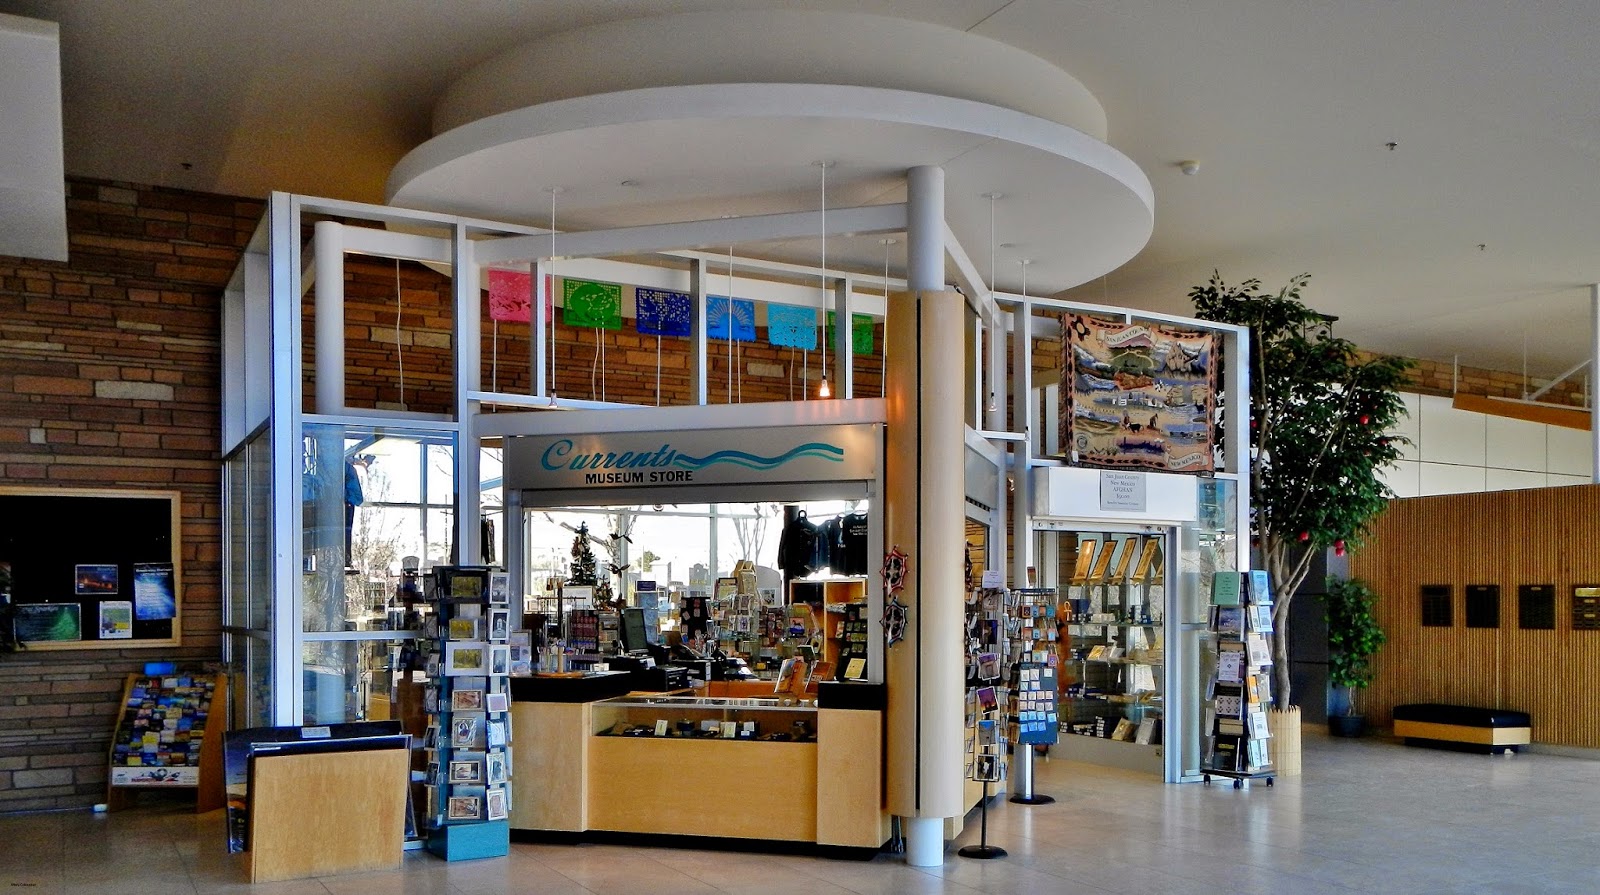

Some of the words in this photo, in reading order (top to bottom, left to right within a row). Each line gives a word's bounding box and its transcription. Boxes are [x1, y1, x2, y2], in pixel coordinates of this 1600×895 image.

[541, 439, 677, 471] Currents
[585, 471, 644, 485] MUSEUM
[650, 470, 694, 483] STORE
